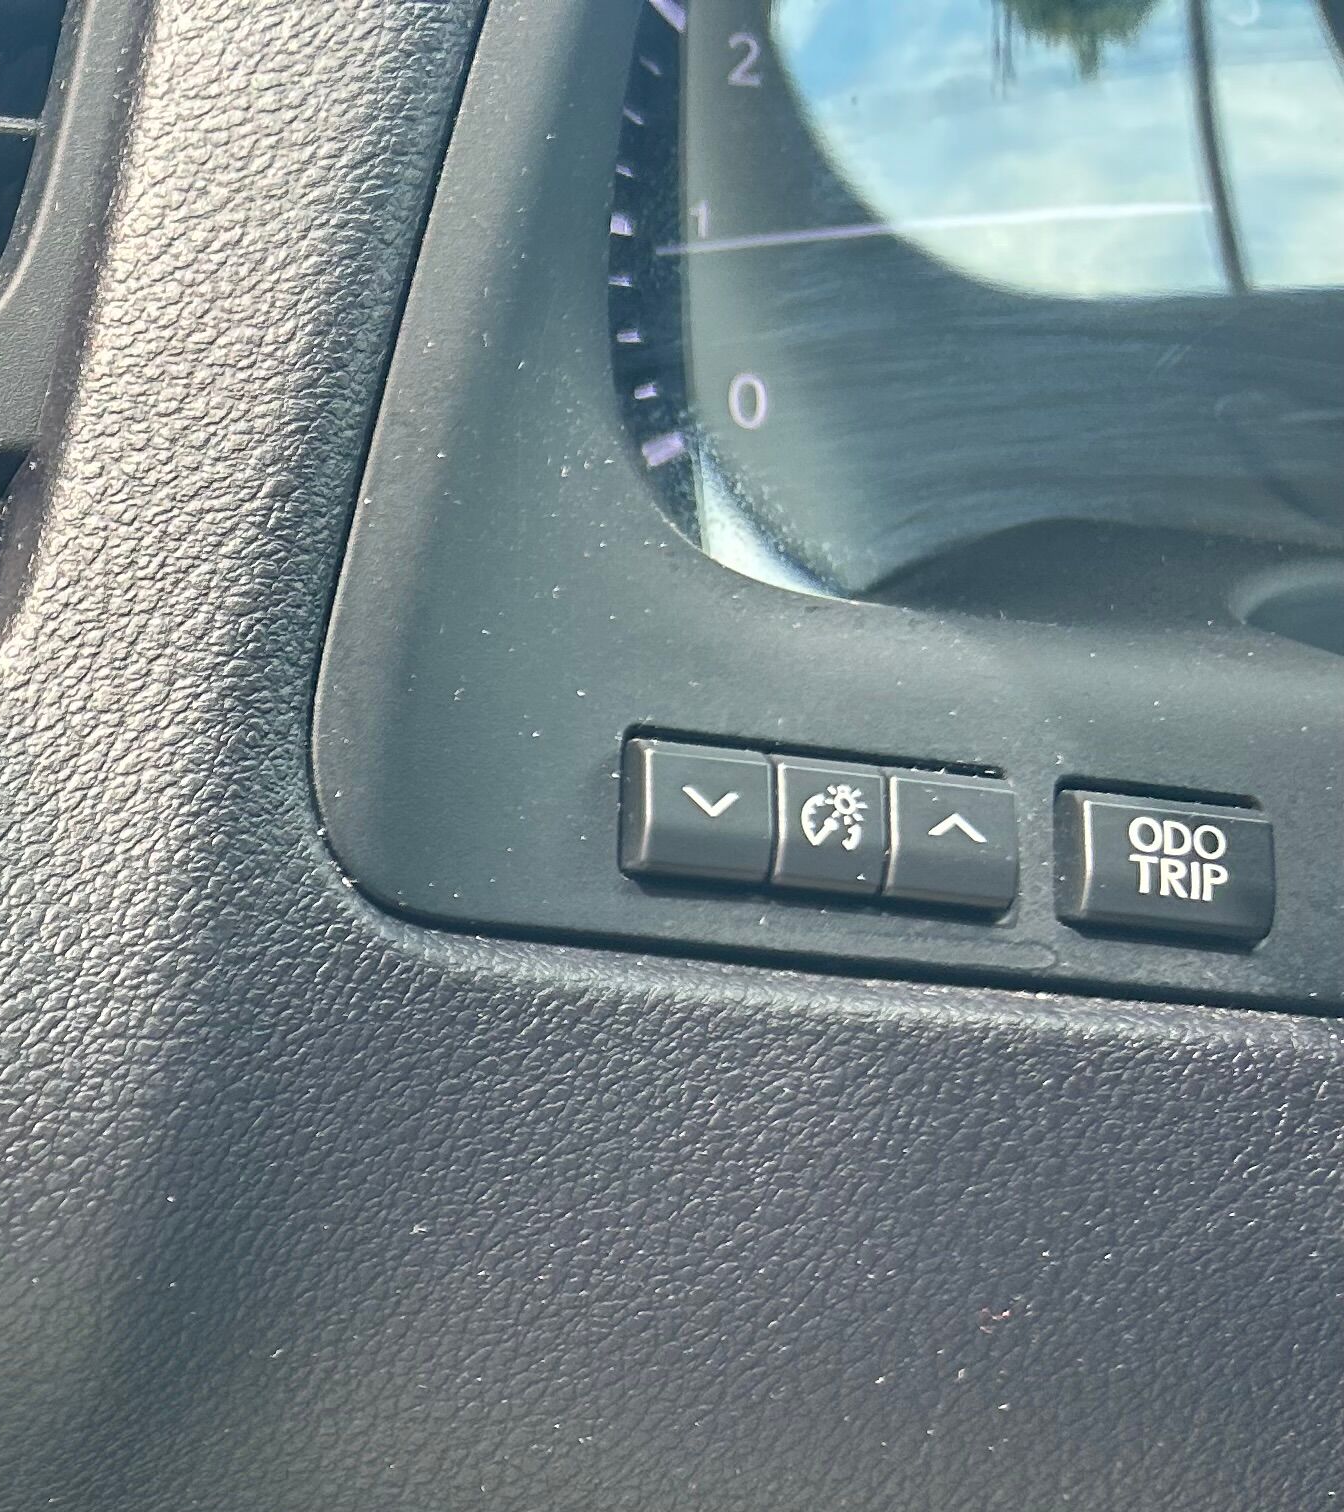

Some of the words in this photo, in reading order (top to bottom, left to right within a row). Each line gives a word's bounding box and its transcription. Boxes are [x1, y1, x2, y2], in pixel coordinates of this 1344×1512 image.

[728, 31, 761, 87] 2
[689, 199, 709, 240] 1
[728, 373, 767, 430] 0
[1128, 816, 1226, 860] ODO
[1128, 853, 1229, 901] TRIP
